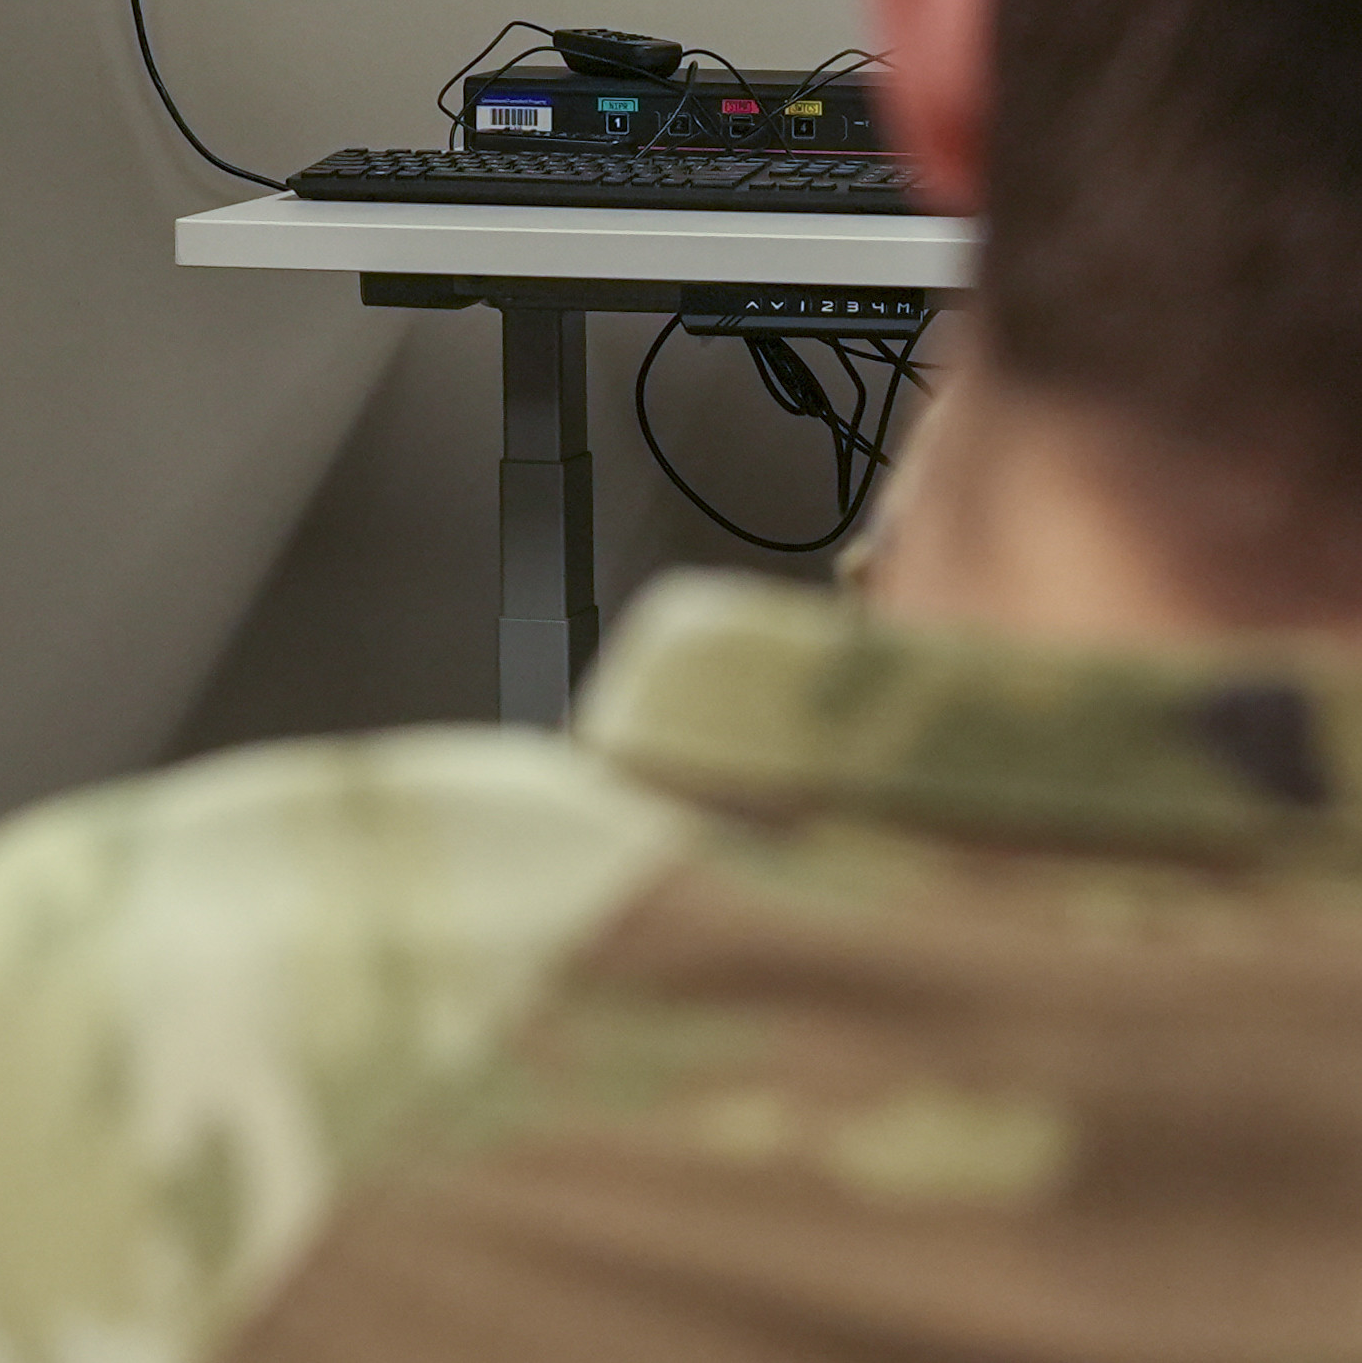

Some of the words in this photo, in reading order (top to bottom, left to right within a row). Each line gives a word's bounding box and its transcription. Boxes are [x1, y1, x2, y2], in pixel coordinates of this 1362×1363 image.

[821, 300, 835, 313] 2
[846, 300, 860, 313] 3
[871, 300, 885, 314] 4
[897, 301, 910, 314] M
